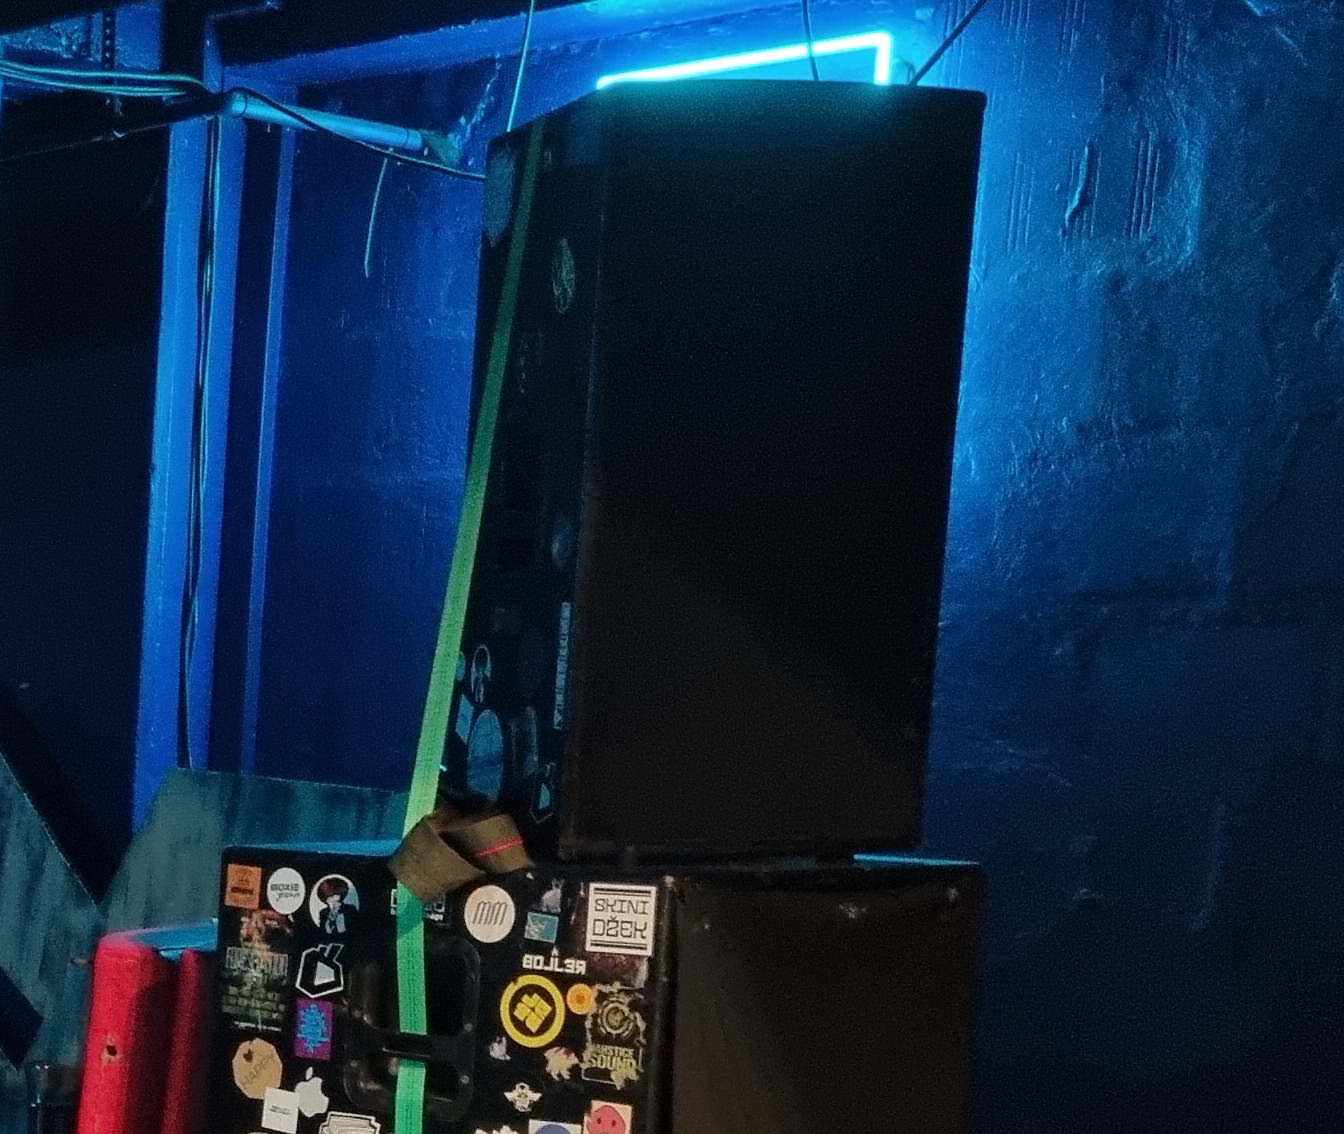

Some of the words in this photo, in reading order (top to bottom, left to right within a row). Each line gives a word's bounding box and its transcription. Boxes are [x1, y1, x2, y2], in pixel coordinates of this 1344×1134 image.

[594, 898, 649, 915] SKINI
[592, 915, 648, 939] DŽEK
[588, 1054, 637, 1070] SOUND
